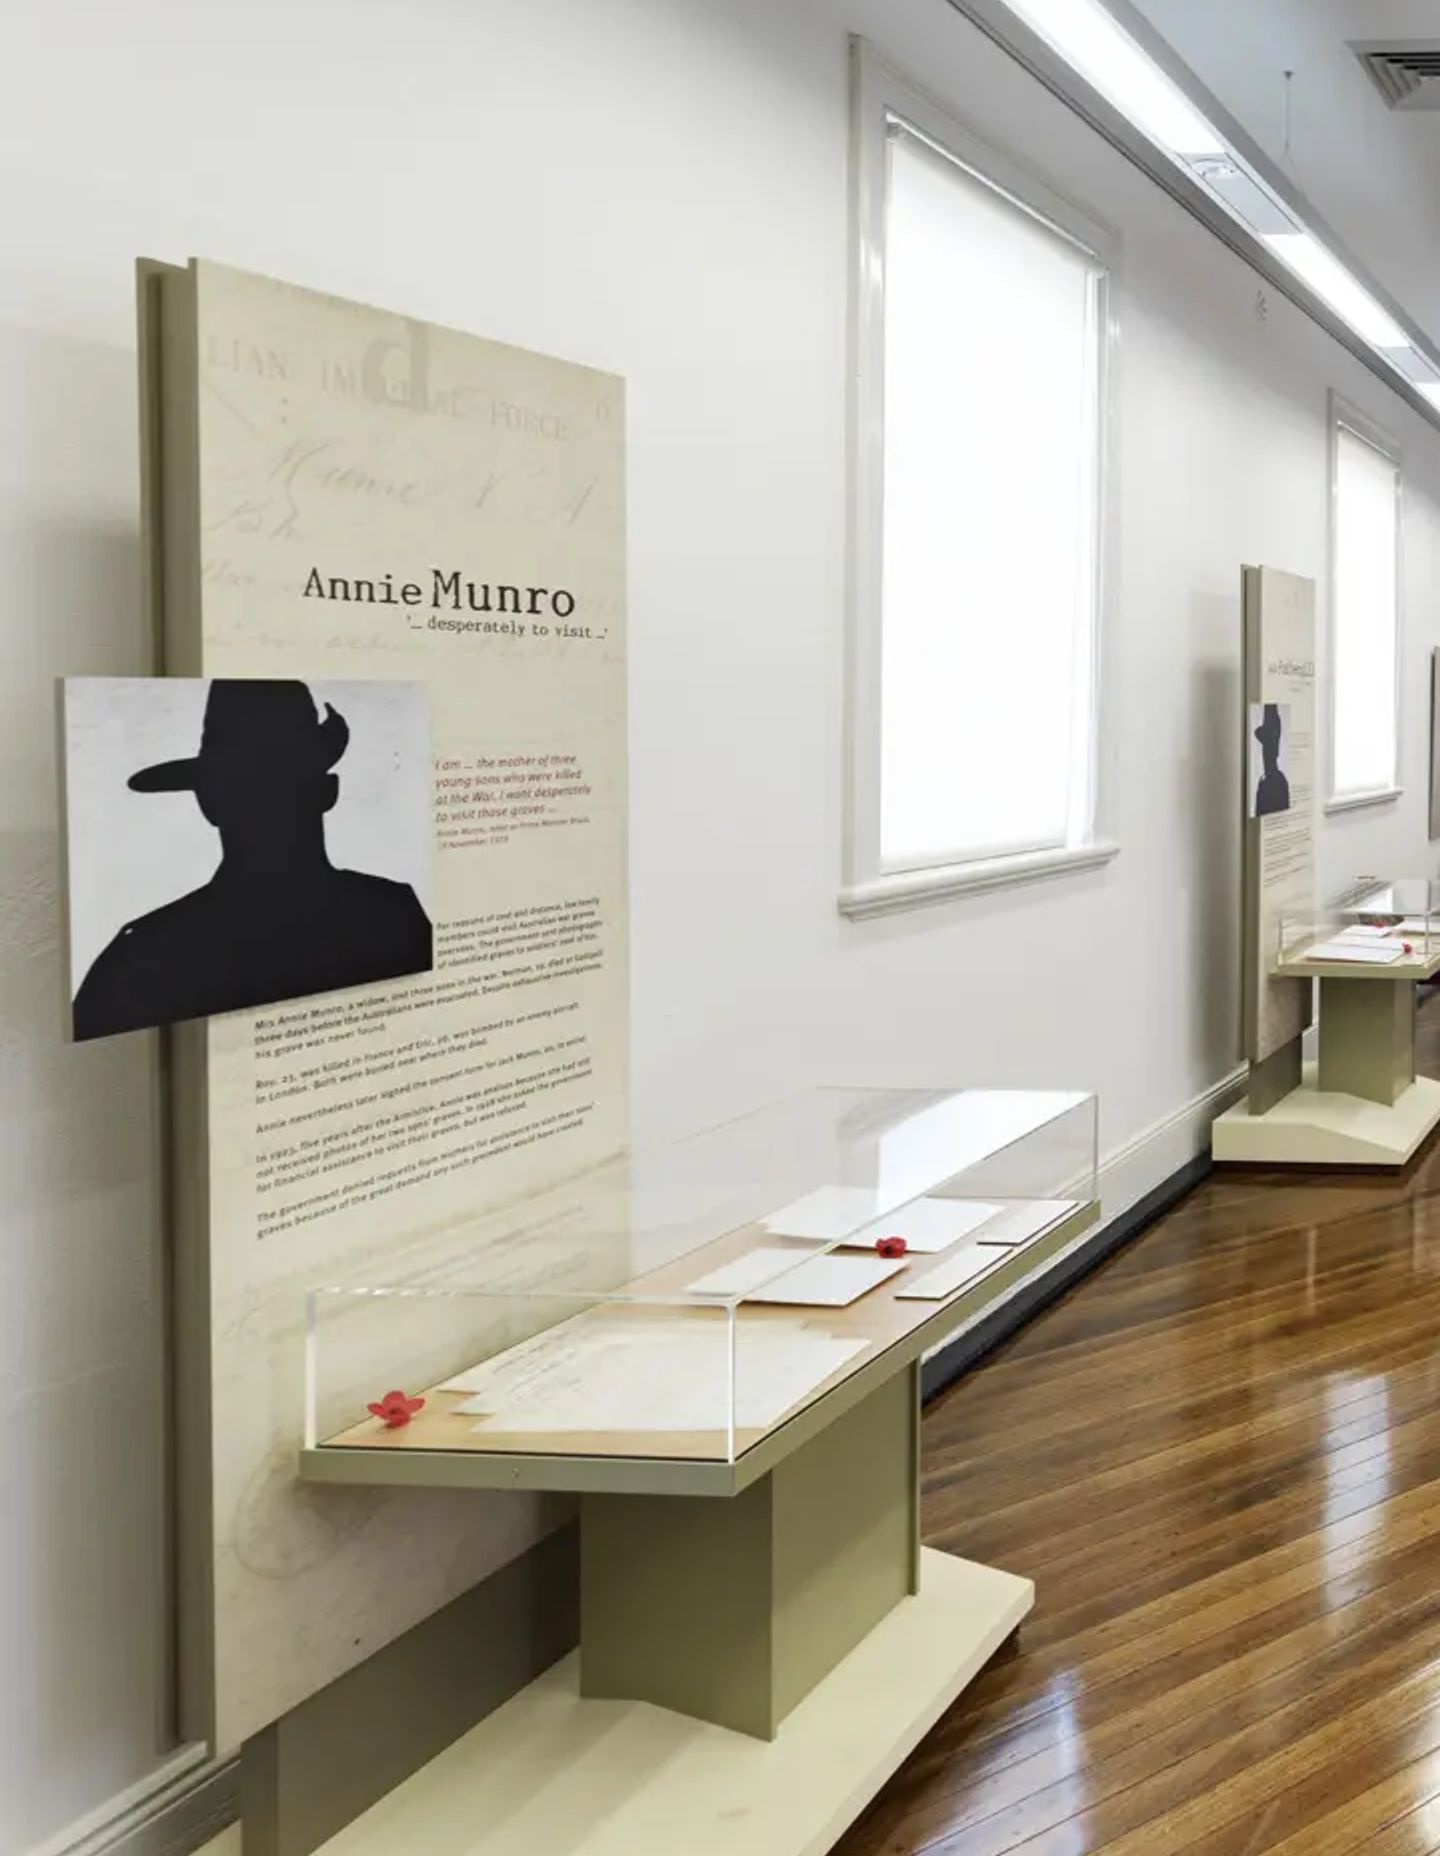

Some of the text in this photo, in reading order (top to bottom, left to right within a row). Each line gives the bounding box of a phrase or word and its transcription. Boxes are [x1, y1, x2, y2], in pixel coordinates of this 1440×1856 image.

[302, 566, 422, 606] Annie
[430, 569, 577, 618] Munro
[427, 615, 526, 638] desperately
[532, 623, 549, 636] to
[555, 624, 592, 639] visit
[476, 757, 495, 768] the
[498, 757, 536, 767] mother
[538, 755, 549, 767] of
[550, 756, 576, 765] three
[436, 769, 581, 790] young sons who were killed
[450, 794, 469, 804] the
[506, 789, 531, 799] want
[436, 805, 545, 823] to visit those graves
[278, 1013, 308, 1025] Annie
[392, 991, 408, 1001] and
[254, 1033, 282, 1045] three
[284, 1027, 309, 1038] days
[310, 1020, 343, 1033] before
[344, 1014, 360, 1025] the
[274, 1043, 303, 1057] grave
[306, 1038, 325, 1048] was
[328, 1031, 355, 1042] never
[300, 1068, 320, 1078] was
[322, 1059, 350, 1072] killed
[396, 1042, 414, 1054] and
[314, 1077, 337, 1089] Both
[340, 1071, 362, 1082] were
[365, 1061, 395, 1076] buried
[256, 1120, 287, 1133] Annie
[290, 1102, 354, 1124] nevertheless
[322, 1131, 349, 1146] years
[376, 1118, 391, 1128] the
[257, 1211, 277, 1222] The
[280, 1189, 340, 1216] government
[342, 1176, 375, 1194] denied
[257, 1221, 292, 1240] graves
[294, 1205, 336, 1225] because
[339, 1198, 349, 1209] of
[351, 1194, 368, 1205] the
[370, 1184, 393, 1200] great
[395, 1171, 432, 1189] demand
